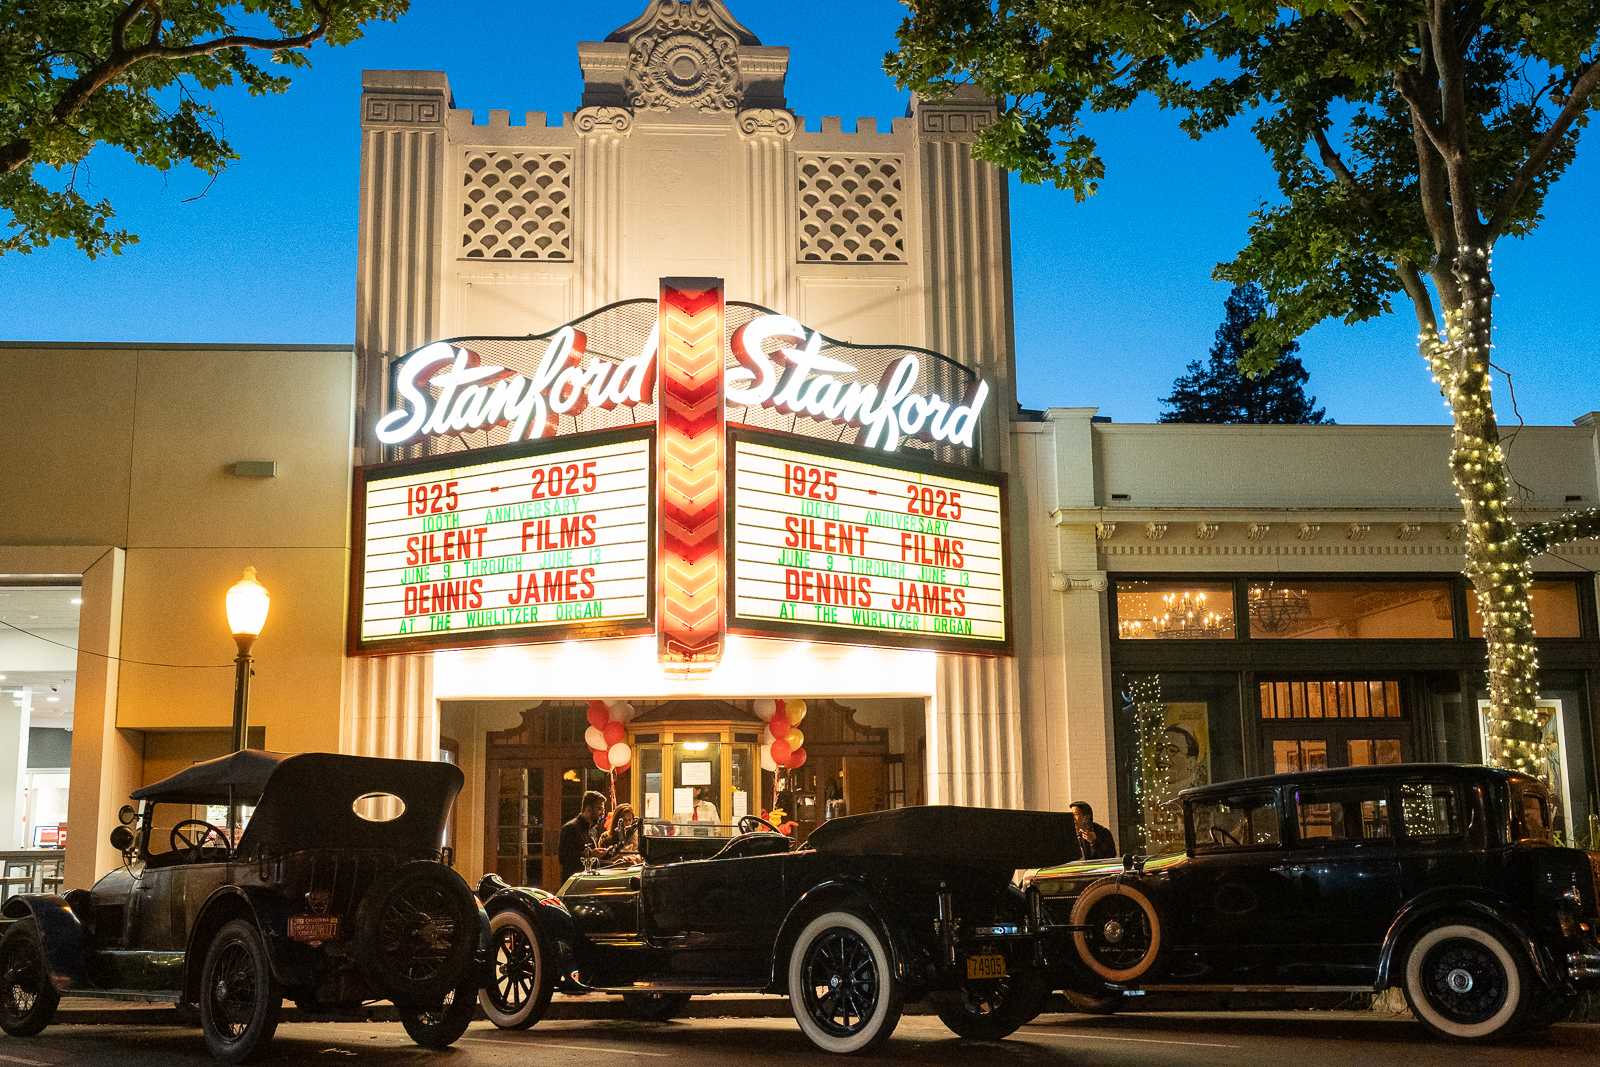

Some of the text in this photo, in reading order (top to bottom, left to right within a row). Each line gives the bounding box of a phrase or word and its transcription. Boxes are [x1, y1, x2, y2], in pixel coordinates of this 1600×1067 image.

[375, 318, 659, 443] Stanford
[725, 314, 989, 452] Stanford
[408, 481, 458, 516] 1925
[532, 461, 597, 499] 2025
[785, 463, 837, 501] 1925
[907, 485, 962, 520] 2025
[406, 514, 597, 565] SILENT FILMS
[422, 497, 580, 533] 100TH ANNIVERSARY
[801, 500, 949, 536] 100TH ANNIVERSARY
[400, 548, 602, 584] JUNE 9 THROUGH JUNE 13
[785, 516, 964, 568] SILENT FILMS
[404, 567, 596, 616] DENNIS JAMES
[778, 549, 970, 587] JUNE 9 THROUGH JUNE 13
[785, 568, 966, 617] DENNIS JAMES
[399, 600, 603, 634] AT THE WURLITZER ORGAN
[779, 602, 972, 635] AT THE WURLITZER ORGAN
[971, 957, 1002, 976] 74905
